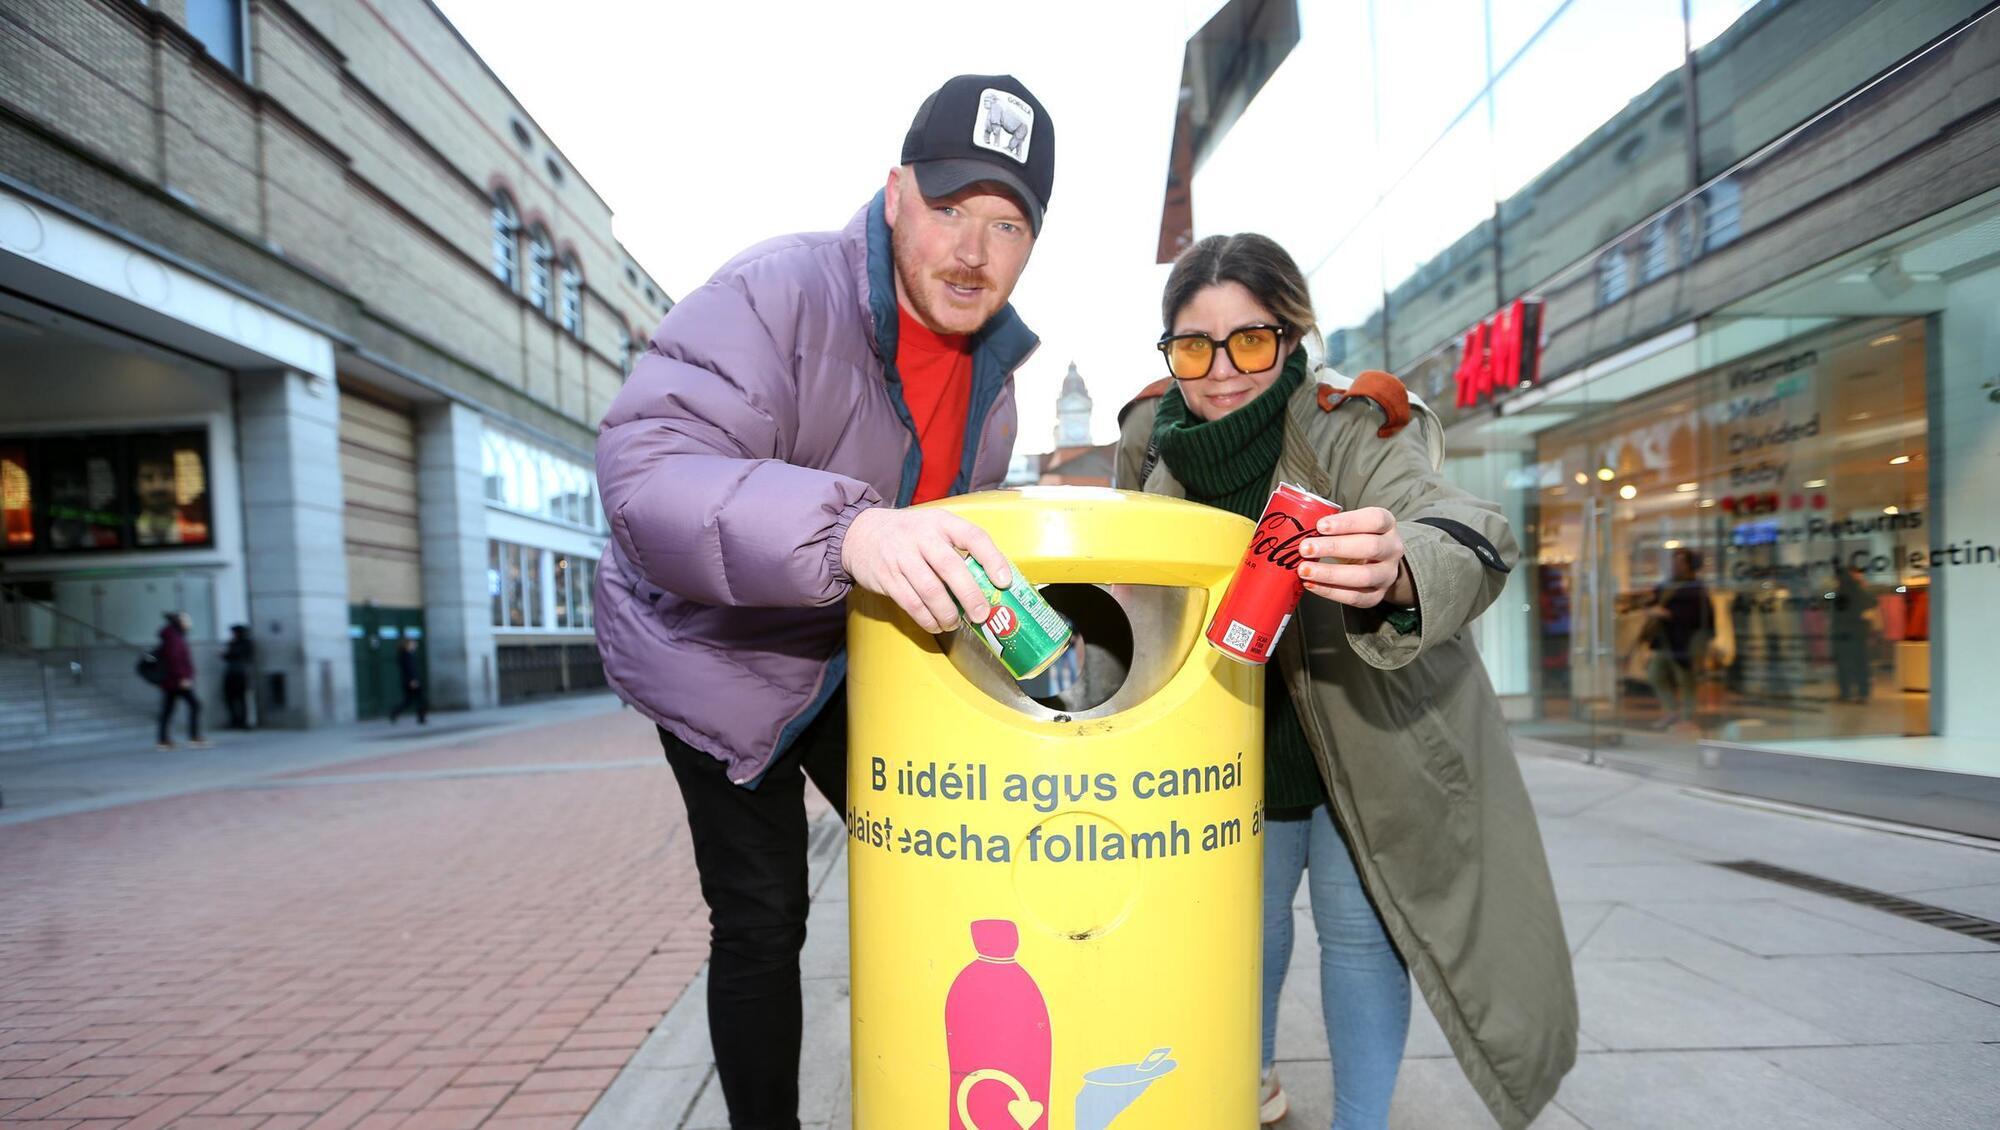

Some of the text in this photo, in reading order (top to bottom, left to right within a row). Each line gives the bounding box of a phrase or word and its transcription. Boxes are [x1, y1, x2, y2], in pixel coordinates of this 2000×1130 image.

[1729, 412, 1820, 454] Divided
[1730, 461, 1790, 487] Baby
[1808, 510, 1922, 542] Returns
[1852, 539, 2000, 573] Collectin
[1003, 773, 1117, 813] agus
[1132, 752, 1242, 799] cannaí
[1026, 820, 1190, 863] follamh
